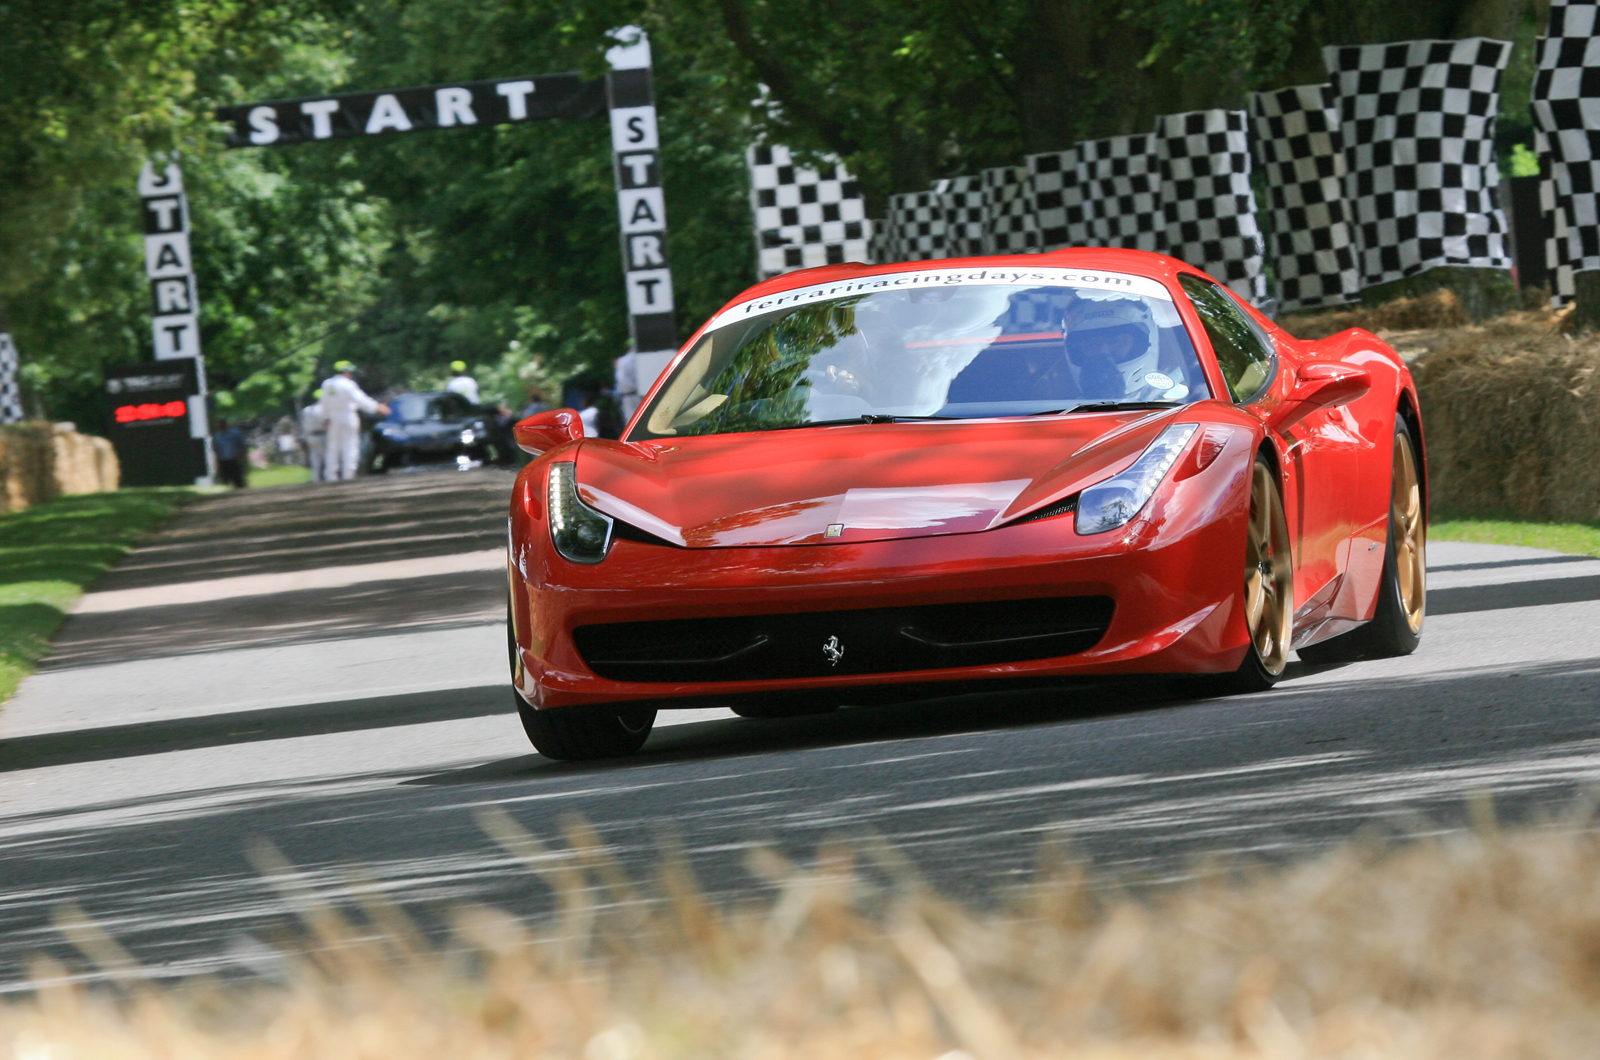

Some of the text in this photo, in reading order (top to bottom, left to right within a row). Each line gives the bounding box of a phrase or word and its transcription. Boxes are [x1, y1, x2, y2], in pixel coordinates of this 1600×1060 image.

[249, 80, 535, 145] START
[622, 116, 664, 305] START
[745, 270, 1132, 313] ferrariracingdays.com
